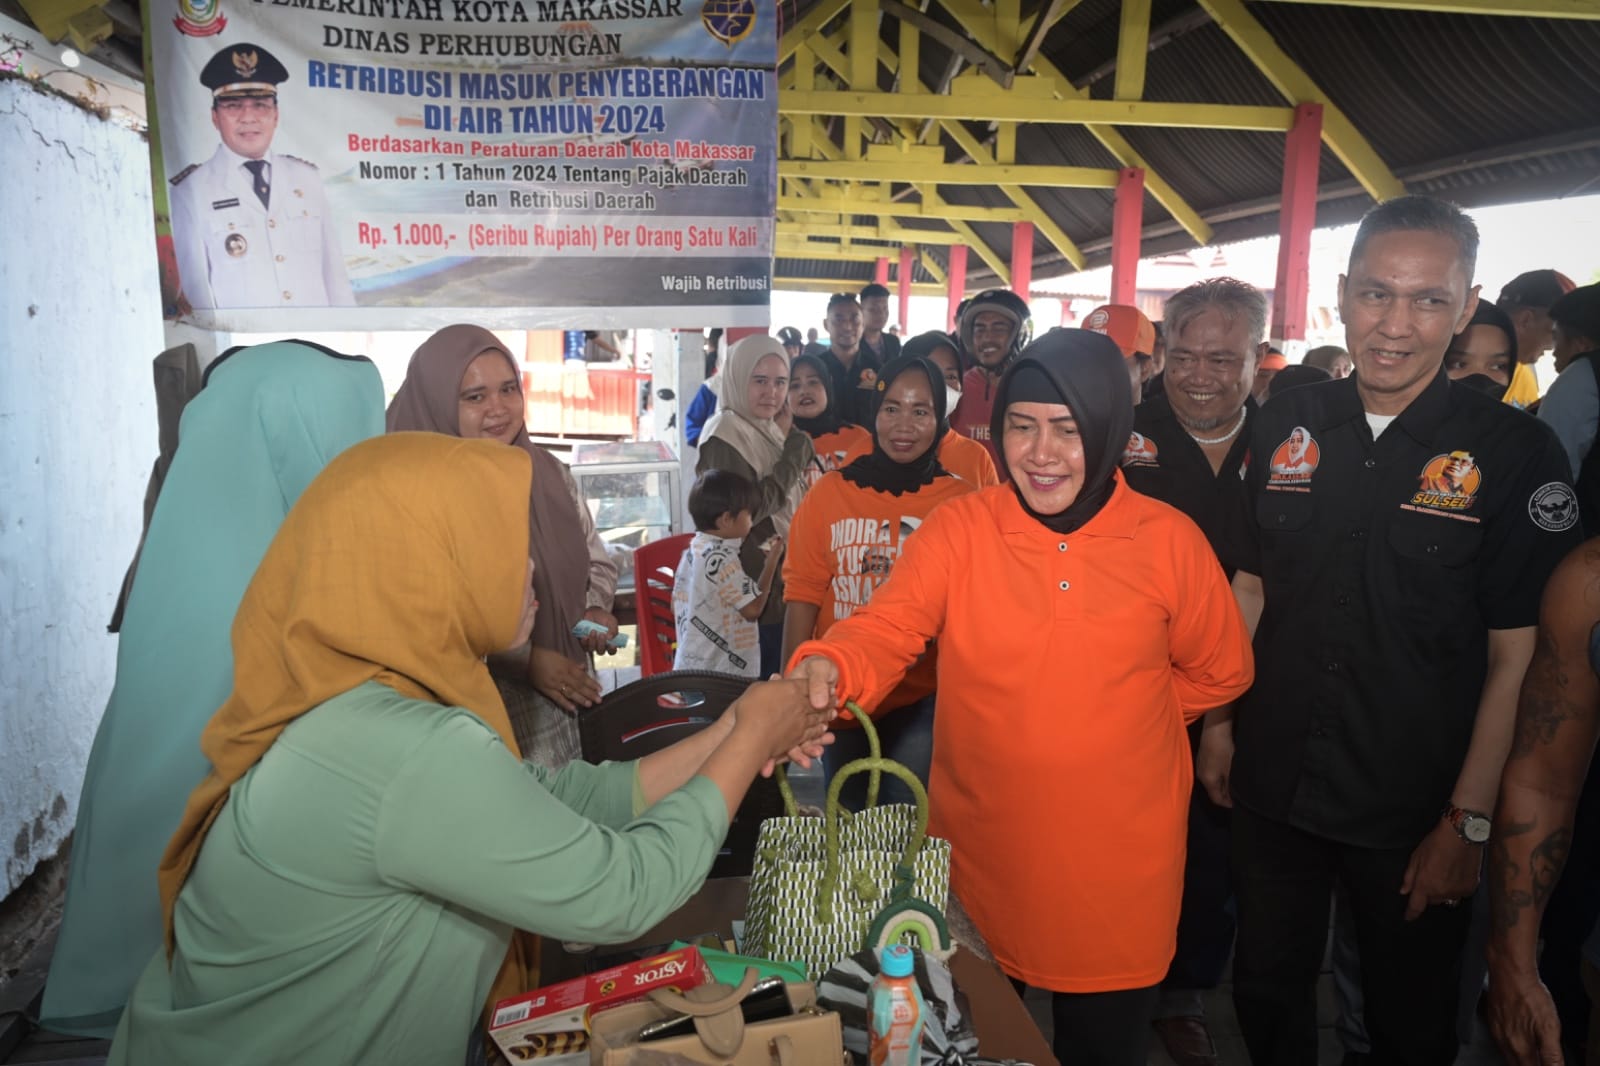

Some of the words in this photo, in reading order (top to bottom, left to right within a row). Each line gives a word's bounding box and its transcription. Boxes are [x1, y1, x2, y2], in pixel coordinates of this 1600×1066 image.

[252, 0, 443, 21] ERINTAH
[454, 0, 528, 23] KOTA
[538, 0, 683, 23] MAKASSAR
[323, 25, 409, 54] DINAS
[419, 33, 622, 56] PERHUBUNGAN
[308, 59, 453, 98] RETRIBUSI
[459, 71, 552, 100] MASUK
[559, 67, 764, 99] PENYEBERANGAN
[424, 104, 450, 132] DI
[459, 104, 502, 134] AIR
[509, 105, 592, 134] TAHUN
[600, 104, 665, 134] 2024
[348, 133, 464, 155] Berdasarkan
[471, 140, 559, 158] Peraturan
[564, 141, 626, 159] Daerah
[632, 140, 670, 158] Kota
[676, 141, 755, 160] Makassar
[359, 161, 417, 180] Nomor
[424, 165, 430, 180] :
[436, 162, 445, 180] 1
[453, 163, 505, 181] Tahun
[512, 164, 558, 181] 2024
[563, 166, 631, 186] Tentang
[638, 166, 685, 188] Pajak
[690, 168, 747, 185] Daerah
[465, 190, 498, 208] dan
[510, 190, 588, 209] Retribusi
[595, 192, 655, 209] Daerah
[358, 222, 387, 249] Rp.
[394, 222, 457, 249] 1.000,-
[469, 223, 529, 250] (Seribu
[534, 224, 598, 250] Rupiah)
[603, 225, 630, 247] Per
[636, 225, 683, 251] Orang
[688, 225, 723, 247] Satu
[729, 226, 757, 247] Kali
[661, 275, 701, 293] Wajib
[706, 275, 768, 290] Retribusi
[1413, 493, 1468, 508] SULSEL
[830, 518, 891, 552] INDIRA
[634, 960, 687, 985] ASTOR
